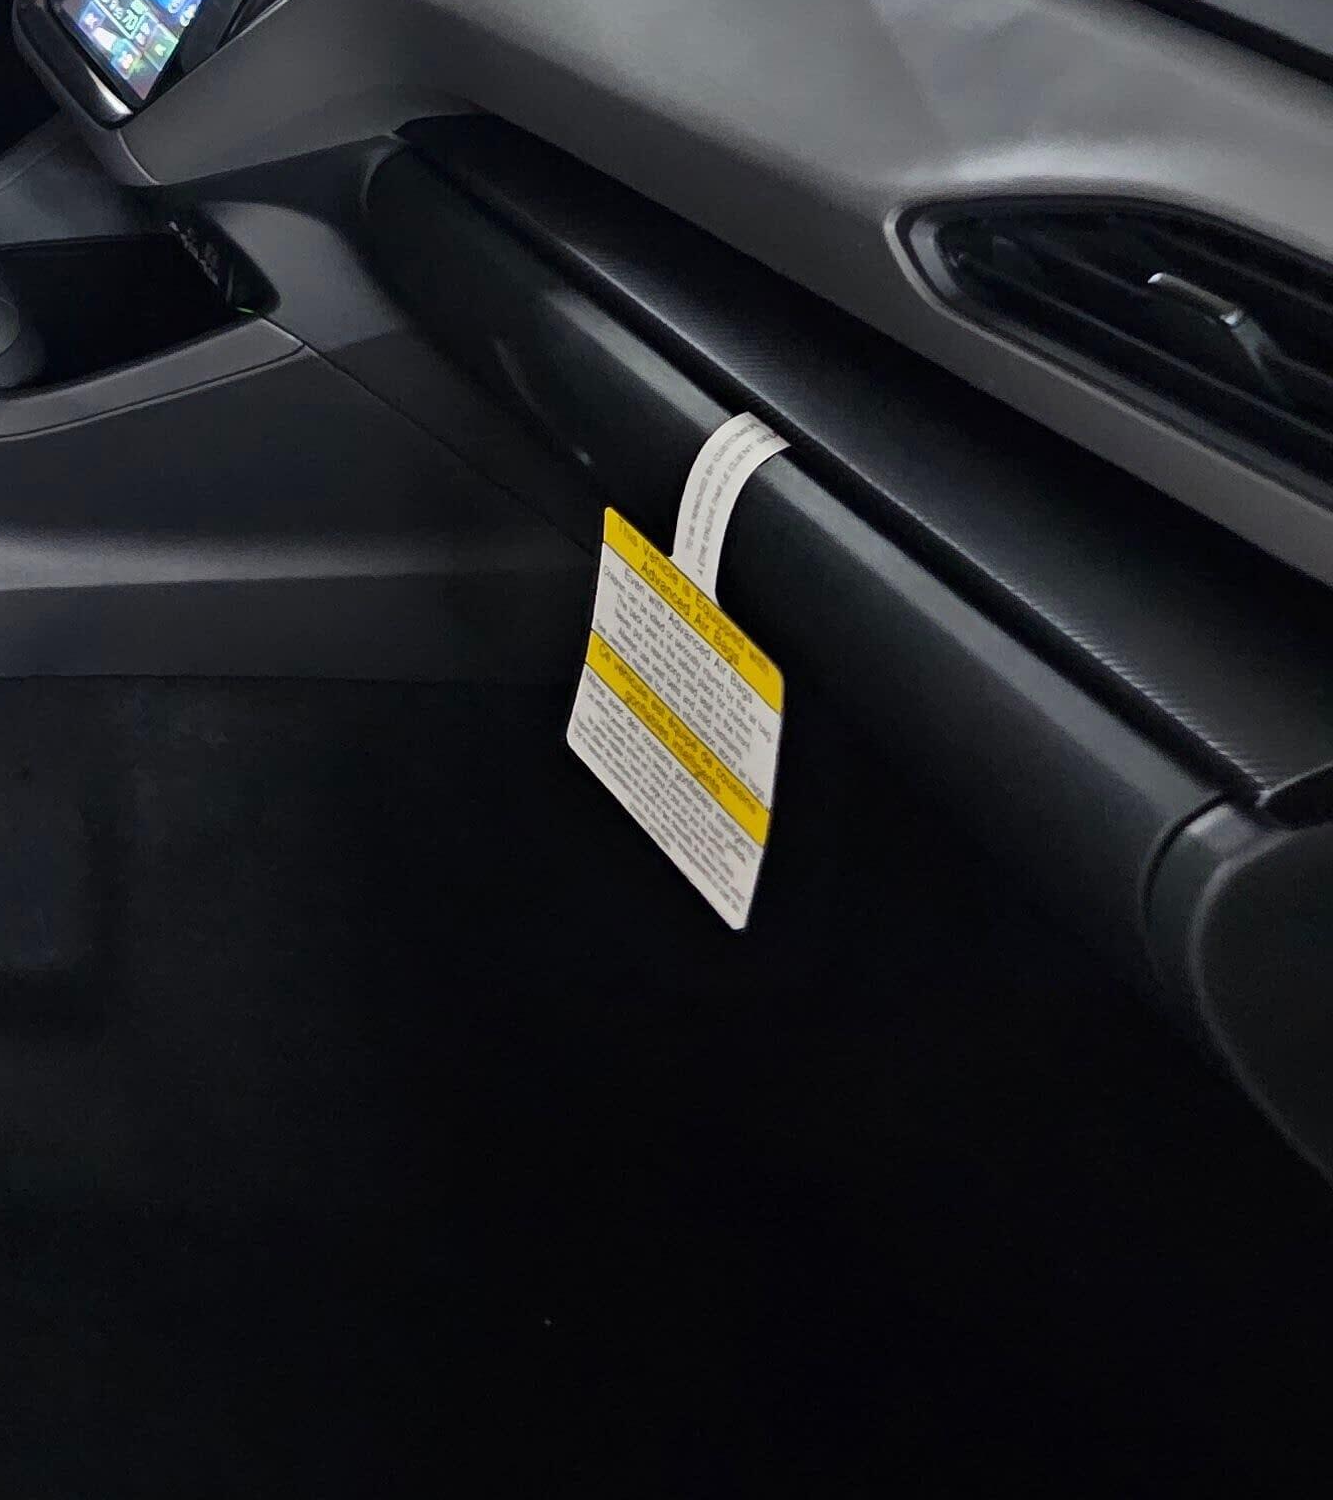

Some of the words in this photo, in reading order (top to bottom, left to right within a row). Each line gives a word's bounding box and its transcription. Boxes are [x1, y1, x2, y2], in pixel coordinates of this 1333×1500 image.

[617, 518, 638, 548] This
[641, 541, 679, 586] Vehicle
[681, 580, 691, 598] is
[694, 592, 745, 651] Equipped
[623, 567, 645, 597] Even
[647, 590, 665, 617] with
[668, 610, 711, 662] Advanced
[713, 654, 728, 678] Air
[728, 670, 753, 707] Bags
[640, 558, 691, 617] Advanced
[694, 610, 710, 635] Air
[712, 628, 741, 669] Bags
